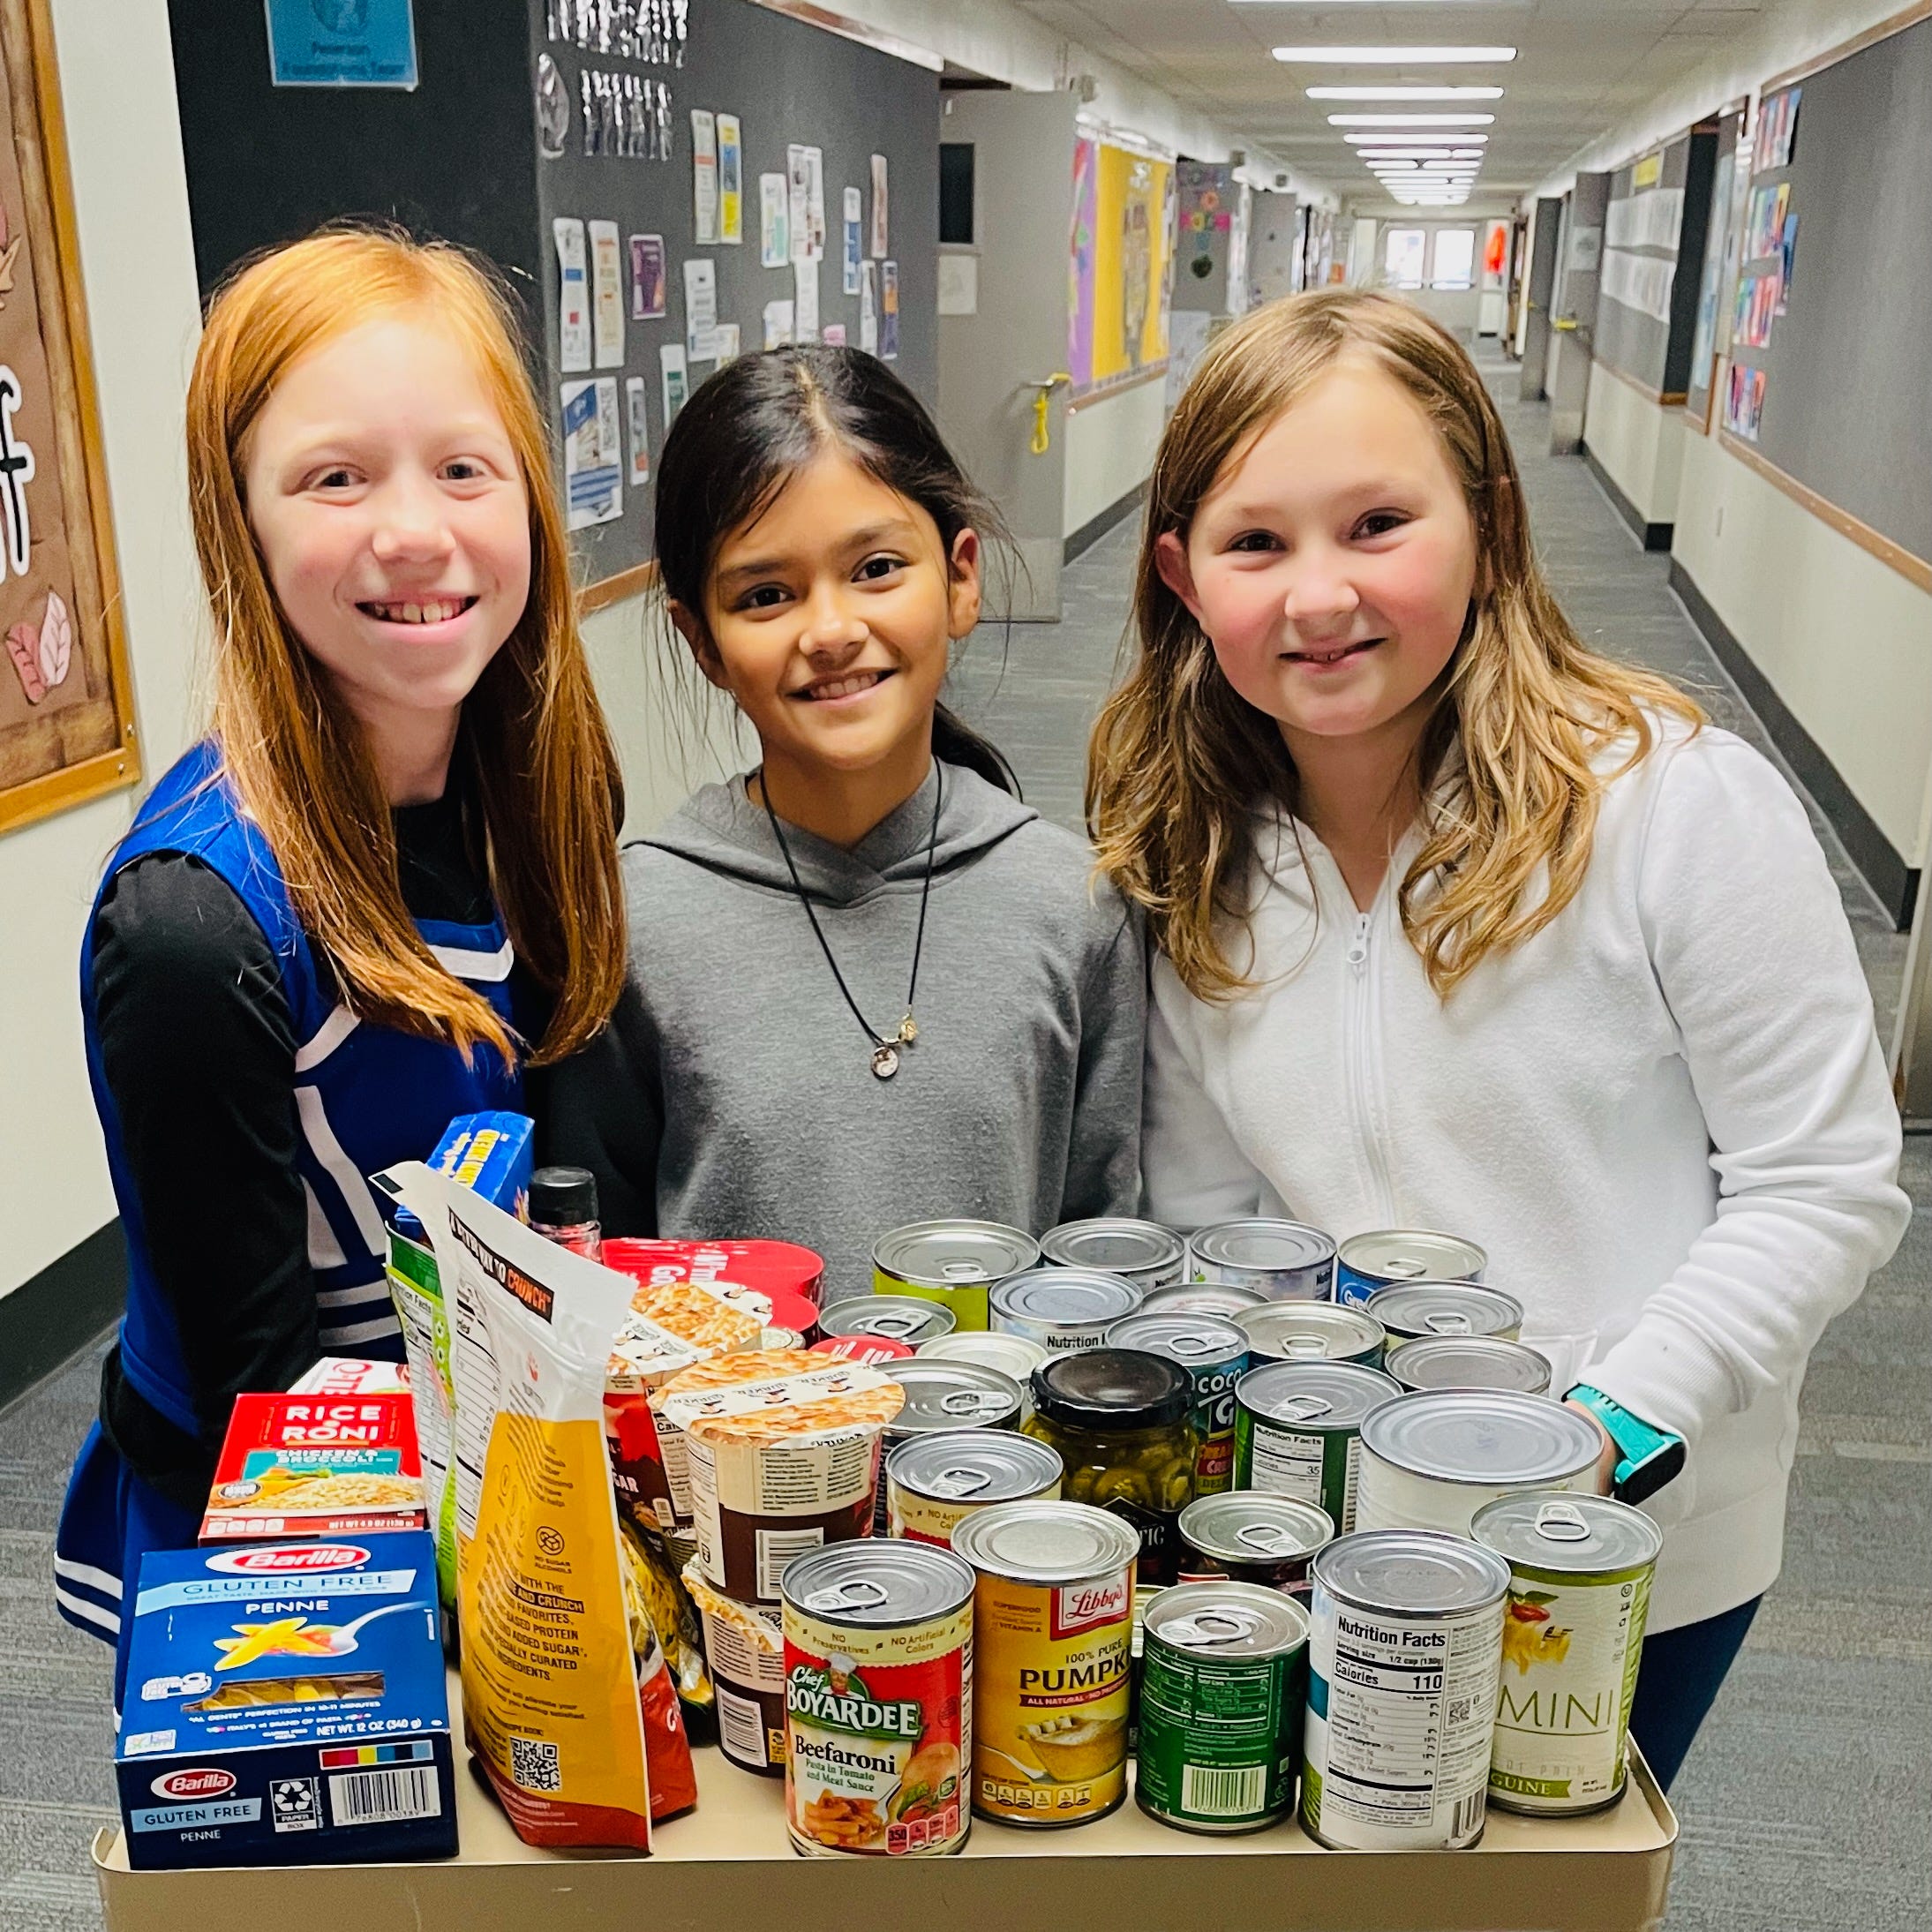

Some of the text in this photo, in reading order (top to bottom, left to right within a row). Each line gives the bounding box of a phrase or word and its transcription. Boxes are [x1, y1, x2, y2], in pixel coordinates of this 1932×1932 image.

[493, 1258, 507, 1283] TO
[507, 1267, 547, 1313] CRUNCH
[1047, 1336, 1099, 1349] Nutrition
[286, 1405, 382, 1421] RICE
[281, 1425, 379, 1440] RONI
[1256, 1425, 1322, 1446] Nutrition Facts
[1306, 1465, 1320, 1476] 35
[928, 1508, 941, 1518] NO
[245, 1548, 357, 1567] Barilla
[184, 1575, 392, 1595] GLUTEN FREE
[545, 1581, 565, 1595] THE
[245, 1599, 329, 1615] PENNE
[538, 1594, 583, 1613] CRUNCH
[533, 1624, 579, 1641] PROTEIN
[999, 1622, 1034, 1633] VITAMIN
[1338, 1616, 1446, 1648] Nutrition Facts
[512, 1630, 540, 1649] ADDED
[813, 1636, 869, 1655] Preservatives
[831, 1633, 846, 1643] NO
[891, 1635, 906, 1646] NO
[906, 1642, 934, 1655] Colors
[1065, 1637, 1123, 1665] 100% PURE
[530, 1653, 578, 1670] CURATED
[1389, 1655, 1402, 1664] 1/2
[793, 1665, 824, 1692] Chef
[1334, 1661, 1442, 1690] Calories 110
[339, 1701, 381, 1710] MINUTES
[786, 1679, 919, 1735] BOYARDEE
[1027, 1696, 1043, 1705] ALL
[1045, 1694, 1085, 1705] NATURAL
[269, 1719, 300, 1728] BRAND
[316, 1725, 336, 1737] NET
[337, 1723, 355, 1734] WT.
[357, 1722, 367, 1733] 12
[368, 1721, 385, 1732] OZ
[795, 1734, 897, 1775] Beefaroni
[806, 1757, 826, 1772] Pasta
[838, 1765, 876, 1781] Tomato
[171, 1774, 229, 1793] Barilla
[807, 1770, 875, 1793] and Meat Sauce
[144, 1805, 252, 1825] GLUTEN FREE
[281, 1814, 310, 1823] PAPER
[180, 1829, 222, 1842] PENNE
[888, 1828, 907, 1841] 350
